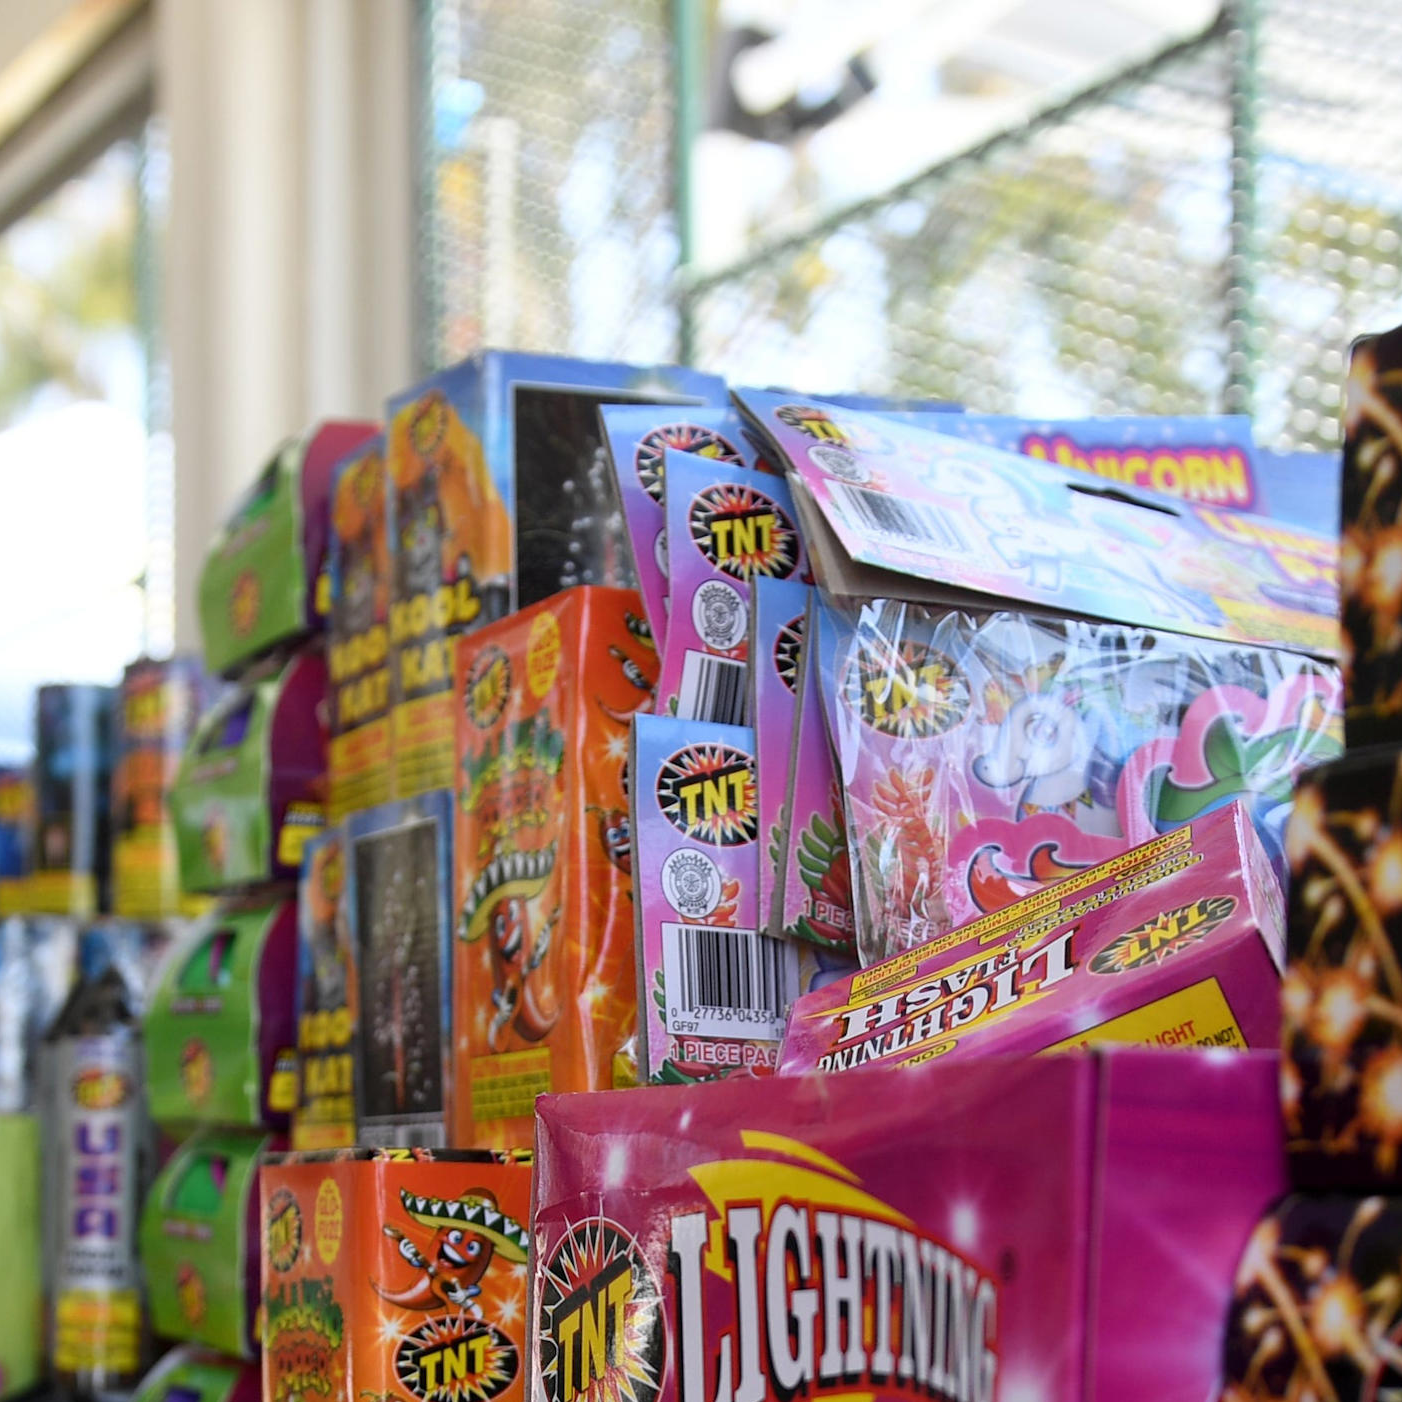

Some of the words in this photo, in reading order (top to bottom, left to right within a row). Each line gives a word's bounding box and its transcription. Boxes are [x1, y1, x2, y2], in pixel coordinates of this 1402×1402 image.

[711, 513, 776, 558] TNT
[679, 767, 750, 825] TNT
[1023, 882, 1066, 905] OTHER
[1069, 865, 1104, 885] READ
[1130, 900, 1206, 958] TNT
[671, 1008, 677, 1017] 0
[694, 1007, 732, 1021] 27736
[818, 930, 1078, 1073] LIGHTNING
[839, 944, 1019, 1043] FLASH
[672, 1020, 699, 1032] GF97
[671, 1042, 679, 1060] 1
[685, 1043, 740, 1063] PIECE
[419, 1332, 495, 1392] TNT
